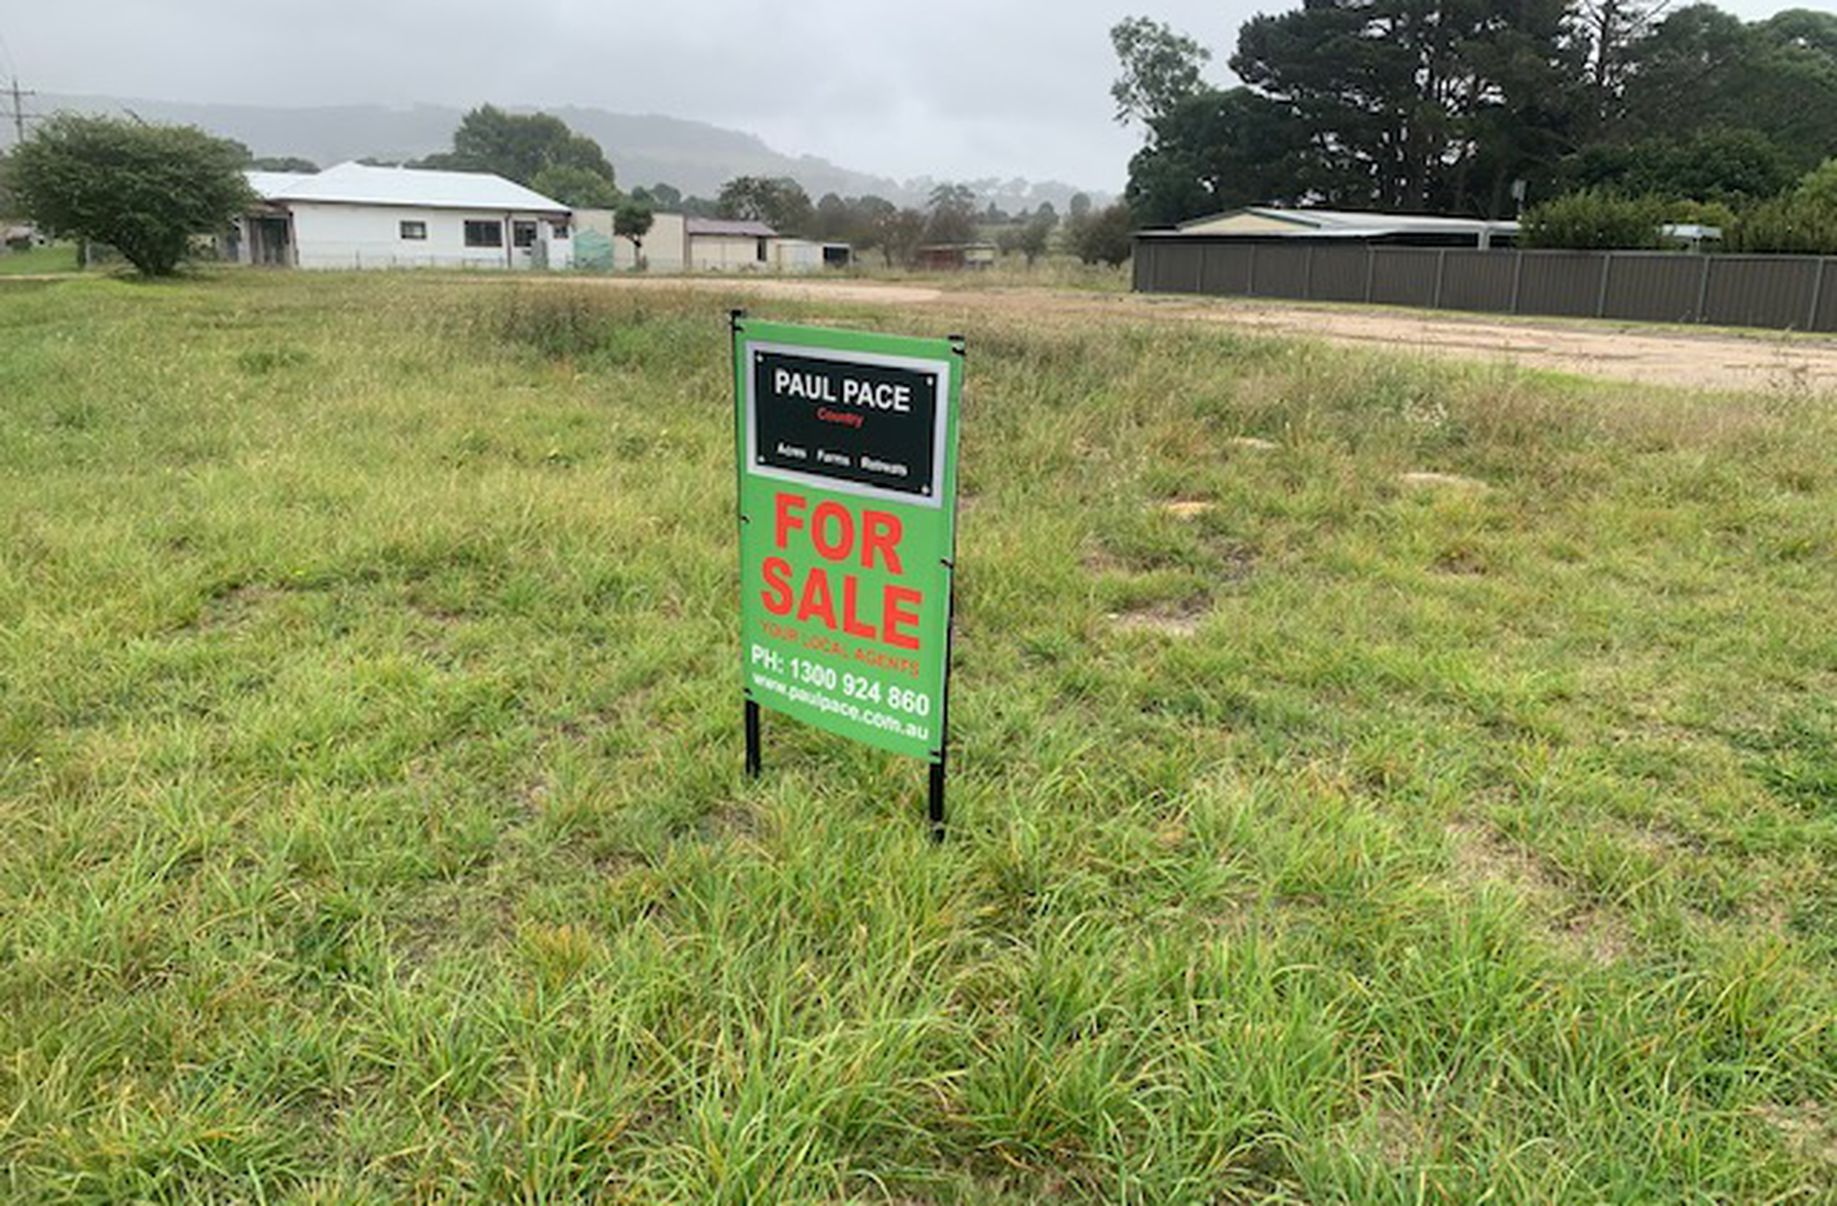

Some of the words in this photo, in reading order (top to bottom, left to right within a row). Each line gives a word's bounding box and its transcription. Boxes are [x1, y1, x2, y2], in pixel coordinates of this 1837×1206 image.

[775, 368, 837, 402] PAUL
[843, 379, 911, 411] PACE
[816, 407, 864, 428] Country
[817, 450, 850, 466] Farms
[775, 492, 904, 575] FOR
[761, 556, 922, 650] SALE
[751, 644, 784, 673] PH:
[790, 658, 837, 690] 1300
[843, 672, 881, 704] 924
[888, 686, 930, 716] 860
[855, 648, 919, 679] AGENTS
[752, 673, 929, 740] www.paulpace.com.au
